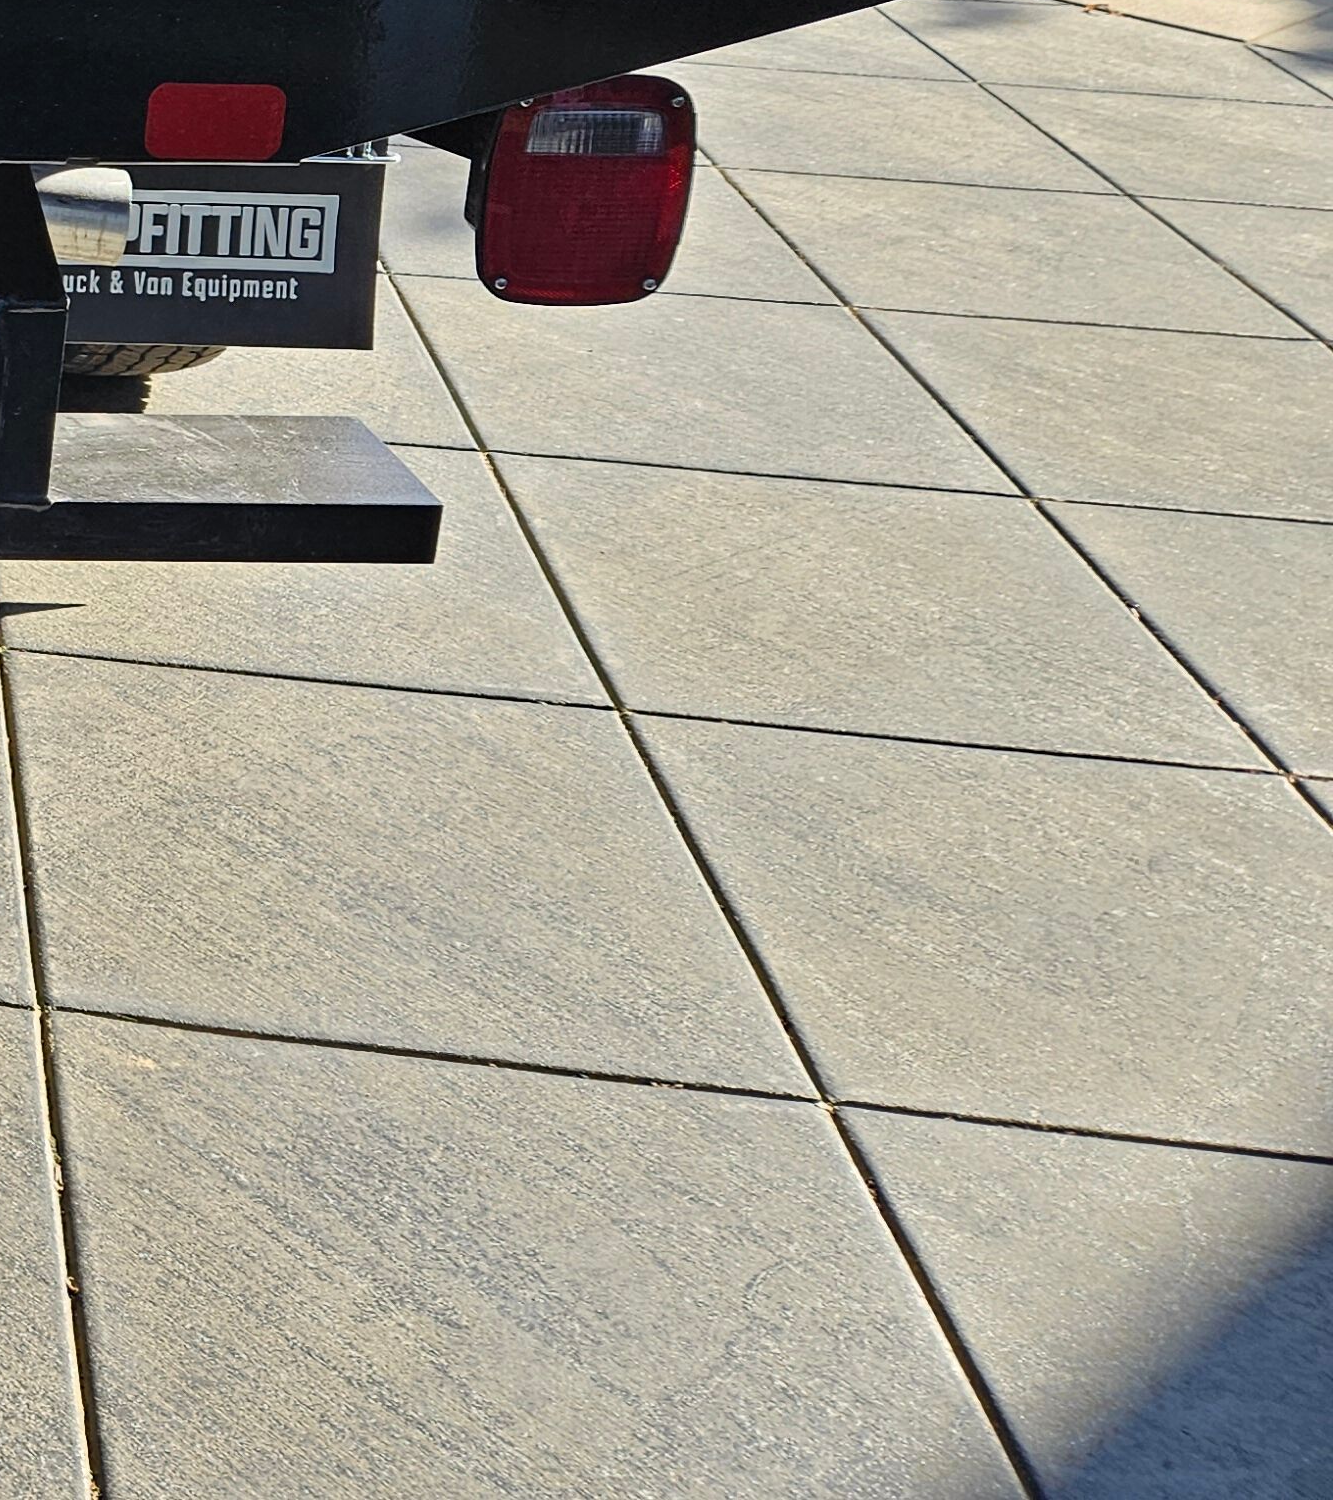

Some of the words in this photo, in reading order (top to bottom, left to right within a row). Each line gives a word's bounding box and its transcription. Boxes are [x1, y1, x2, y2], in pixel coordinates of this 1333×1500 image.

[126, 203, 321, 258] FITTING
[63, 269, 100, 293] uck
[109, 270, 124, 294] &
[134, 271, 173, 295] Van
[182, 272, 299, 302] Equipment
